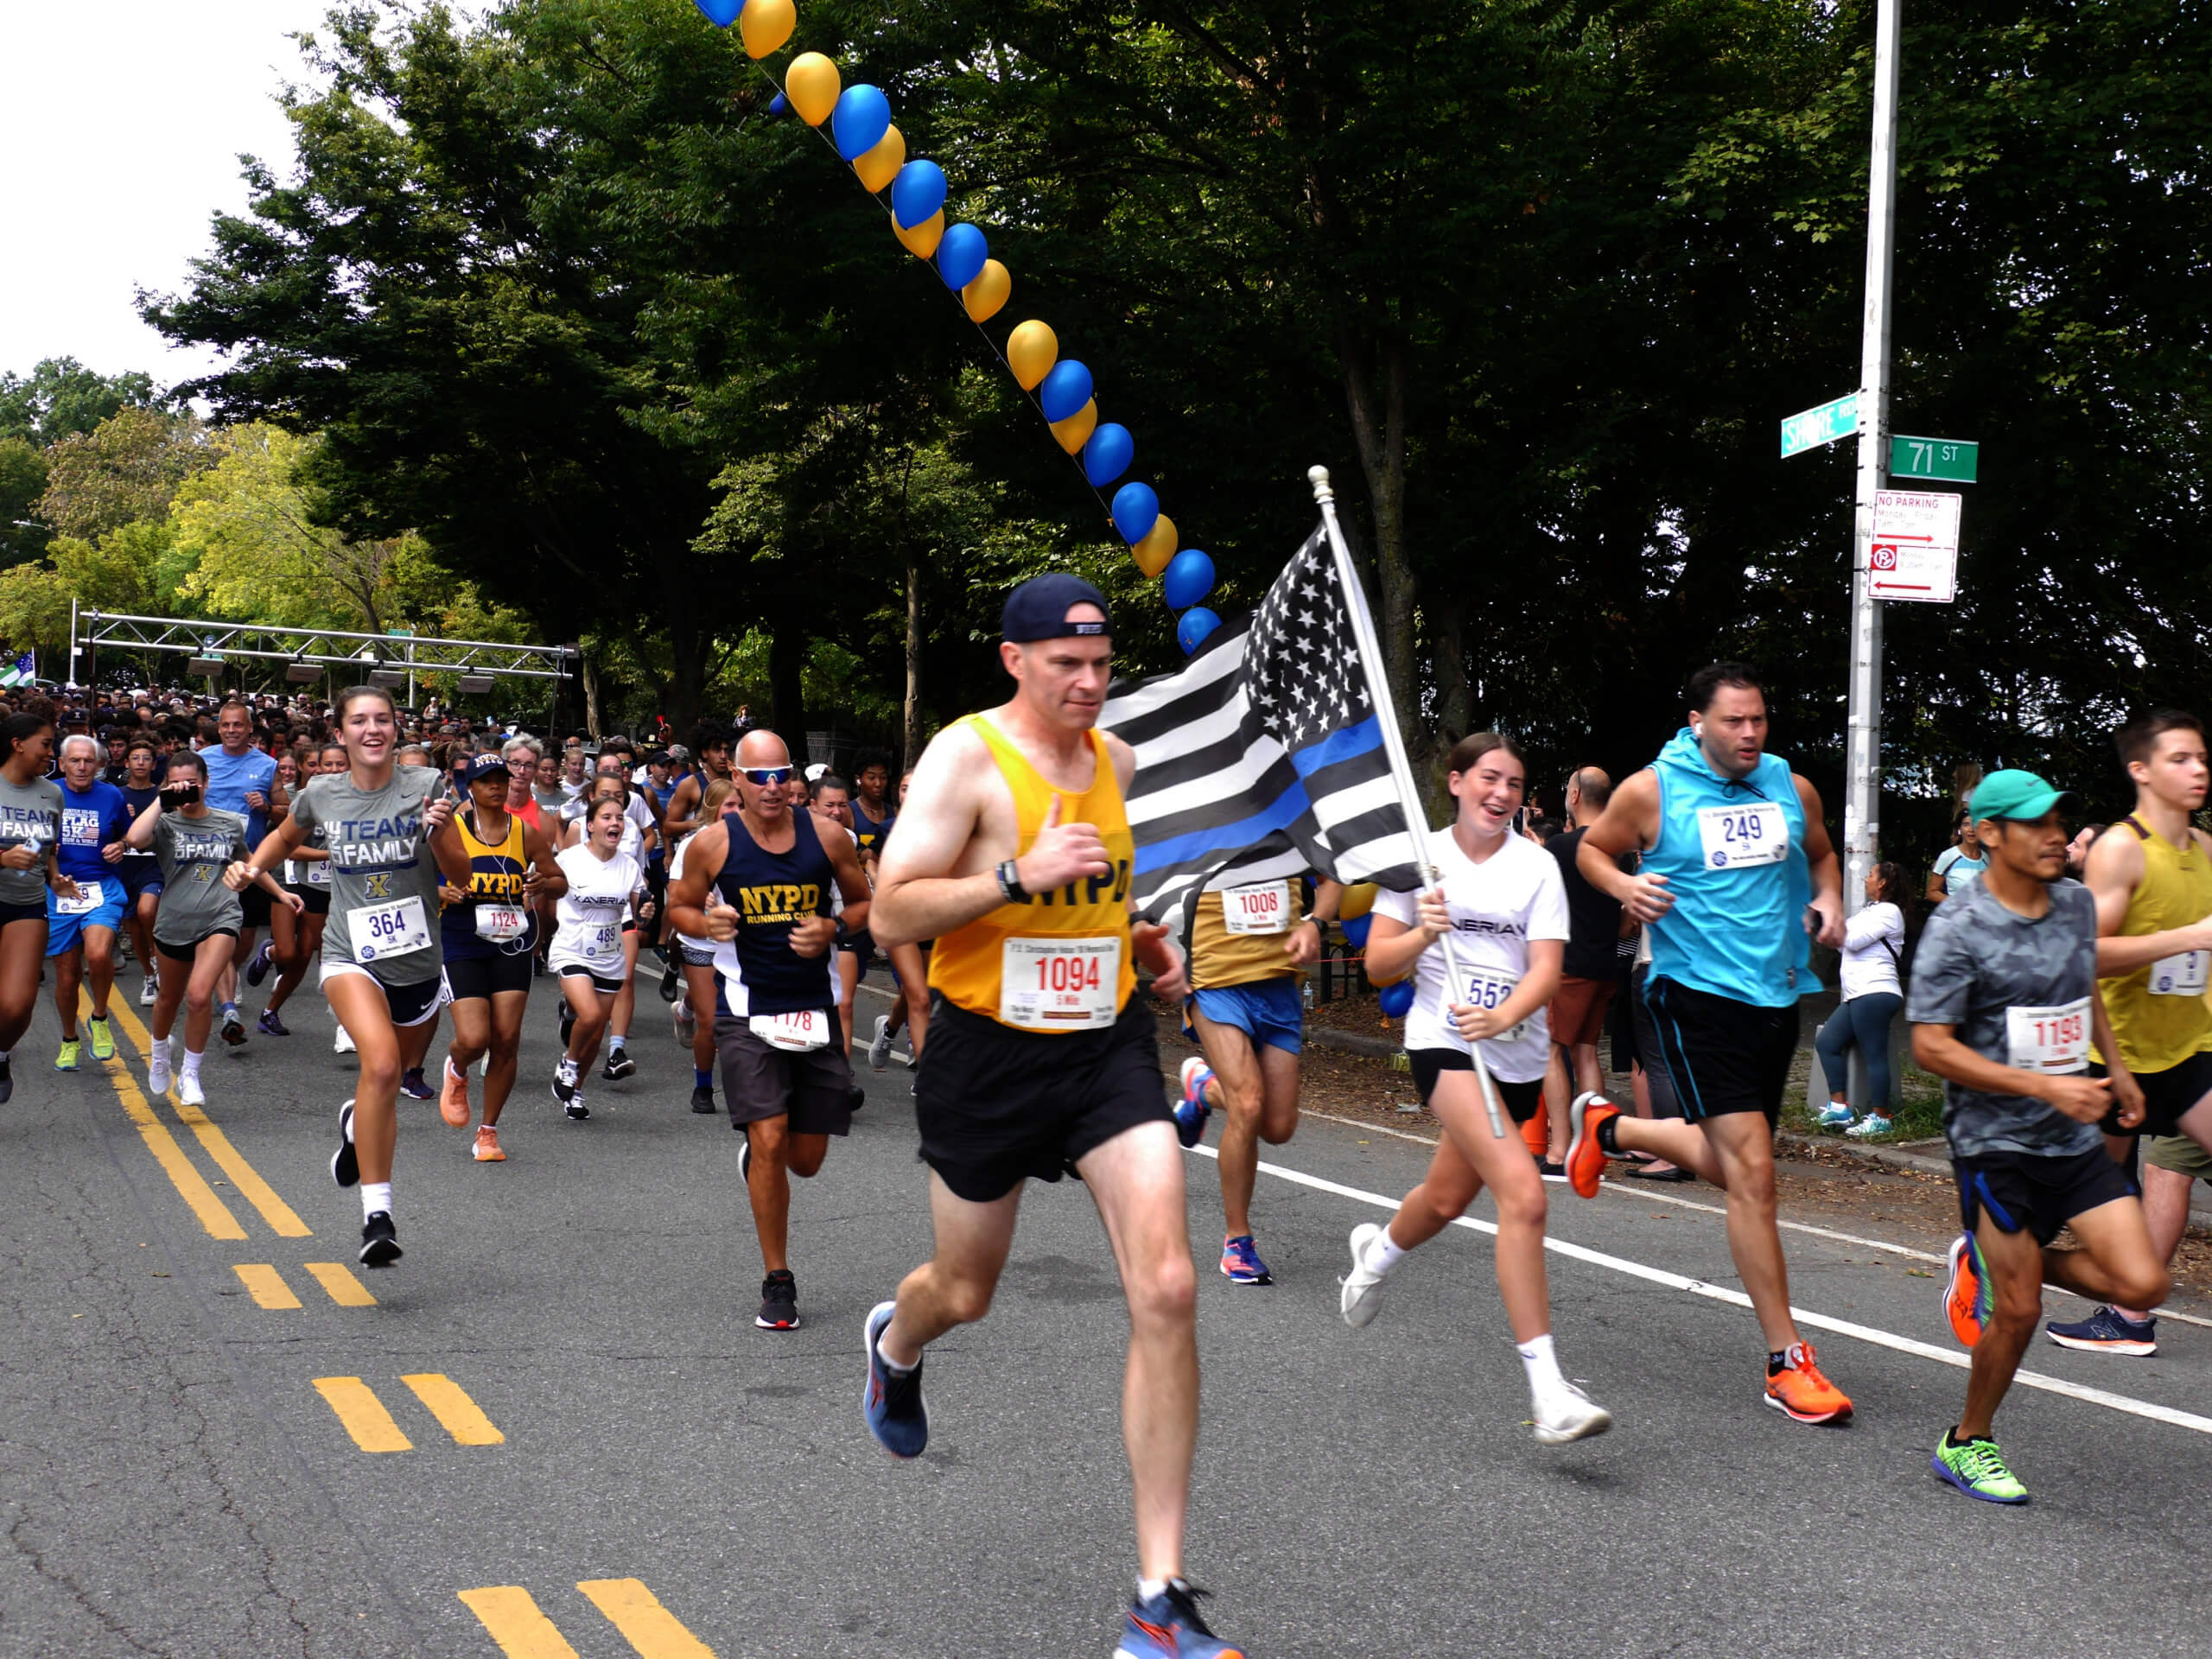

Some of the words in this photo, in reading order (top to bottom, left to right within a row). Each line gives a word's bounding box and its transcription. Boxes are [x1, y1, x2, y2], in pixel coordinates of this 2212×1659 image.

[1786, 407, 1836, 450] SHRE
[1909, 442, 1933, 474] 71
[1942, 445, 1959, 461] ST
[1878, 497, 1892, 506] NO
[1896, 498, 1939, 509] PARKING
[62, 817, 99, 828] FLAG
[62, 826, 84, 838] 5K
[341, 815, 417, 842] TEAM
[1723, 815, 1762, 842] 249
[186, 843, 234, 859] FAMILY
[343, 836, 417, 865] FAMILY
[470, 873, 523, 894] NYPD
[574, 894, 629, 905] XAVERIA
[740, 884, 820, 914] NYPD
[1239, 892, 1278, 914] 1008
[369, 910, 405, 938] 364
[491, 912, 518, 927] 1124
[747, 912, 792, 925] RUNNING
[597, 927, 615, 943] 489
[1034, 957, 1100, 992] 1094
[2033, 1014, 2082, 1046] 1193
